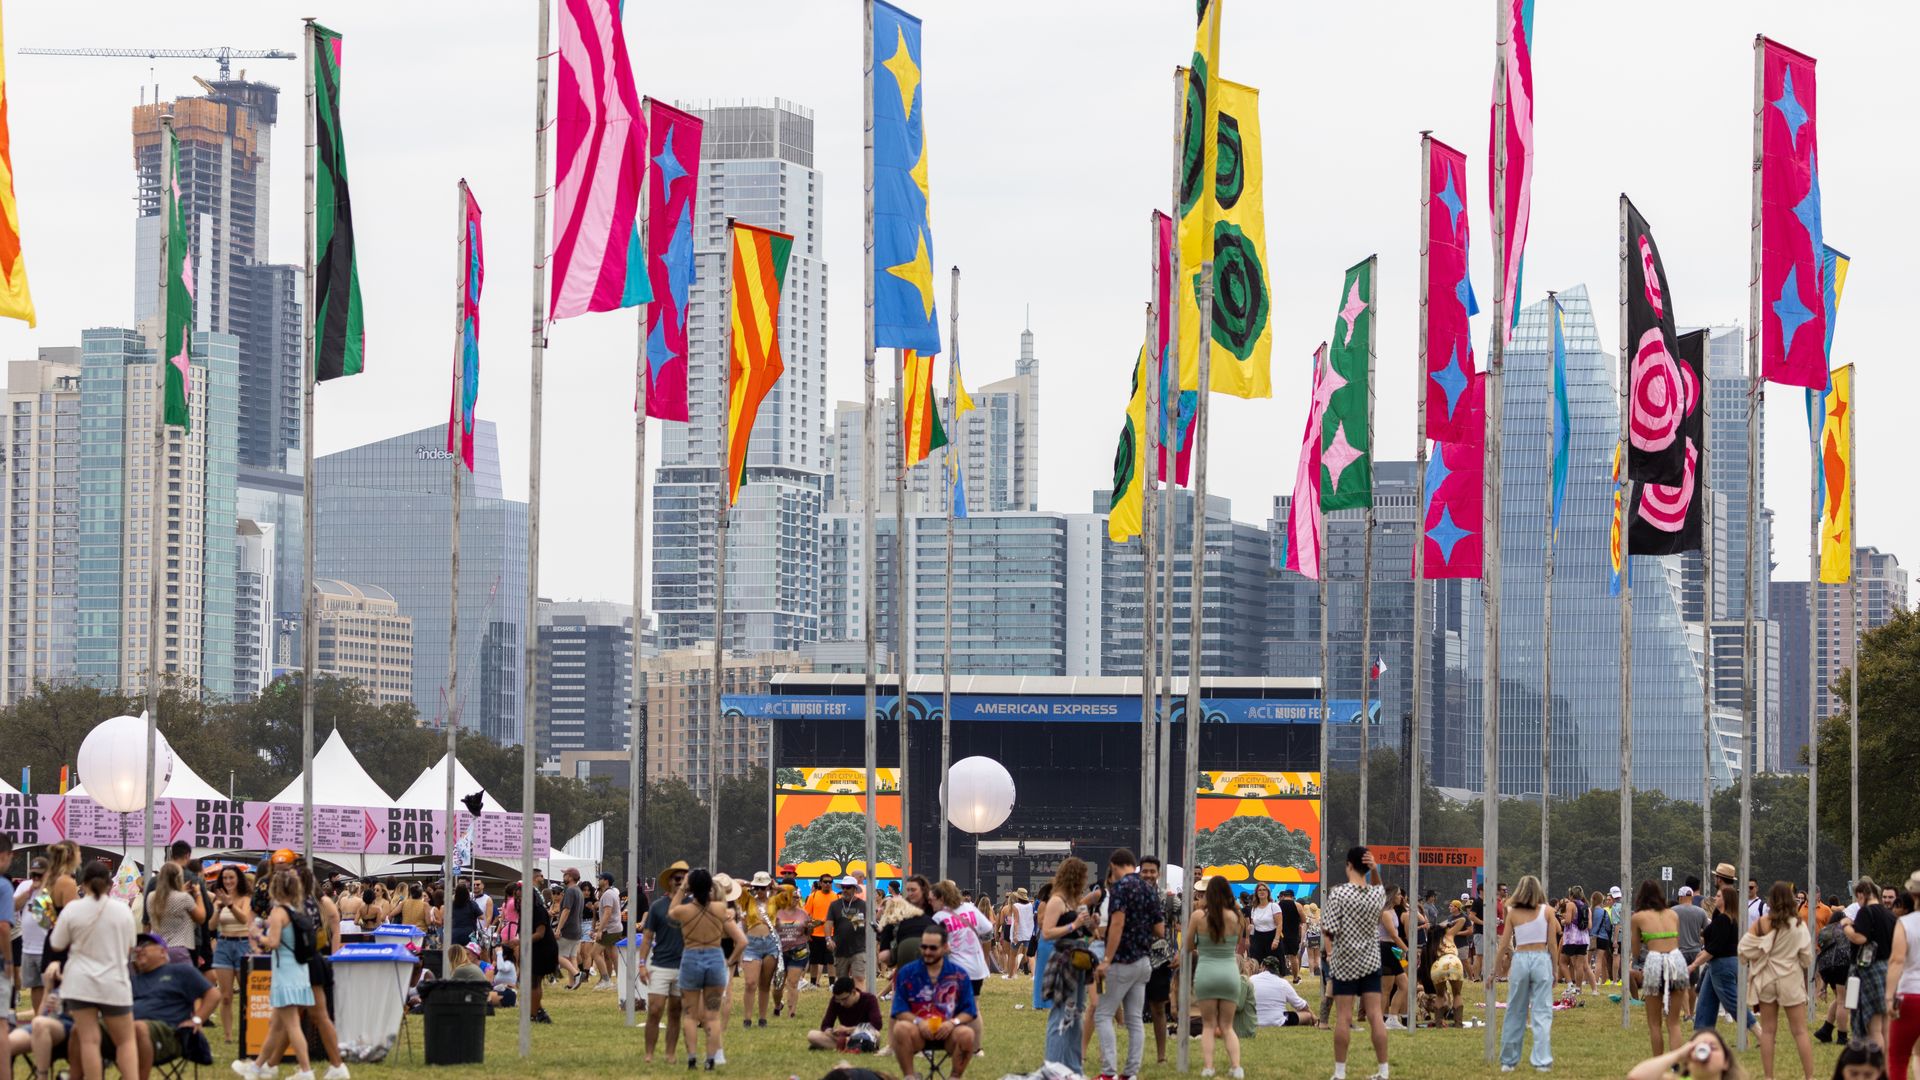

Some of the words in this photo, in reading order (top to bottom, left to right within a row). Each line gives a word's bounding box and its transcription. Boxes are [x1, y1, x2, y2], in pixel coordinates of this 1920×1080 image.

[418, 447, 454, 460] indee
[764, 703, 790, 715] ACL
[791, 703, 822, 715] MUSIC
[824, 703, 847, 715] FEST
[974, 703, 1048, 714] AMERICAN
[1053, 704, 1118, 715] EXPRESS
[1248, 706, 1274, 719] ACL
[1275, 707, 1306, 719] MUSIC
[1309, 707, 1331, 719] FET
[0, 793, 39, 807] AR
[0, 808, 39, 830] AR
[196, 813, 244, 836] BAR
[388, 821, 433, 842] BAR
[1419, 852, 1444, 864] USIC
[1446, 852, 1468, 865] FEST
